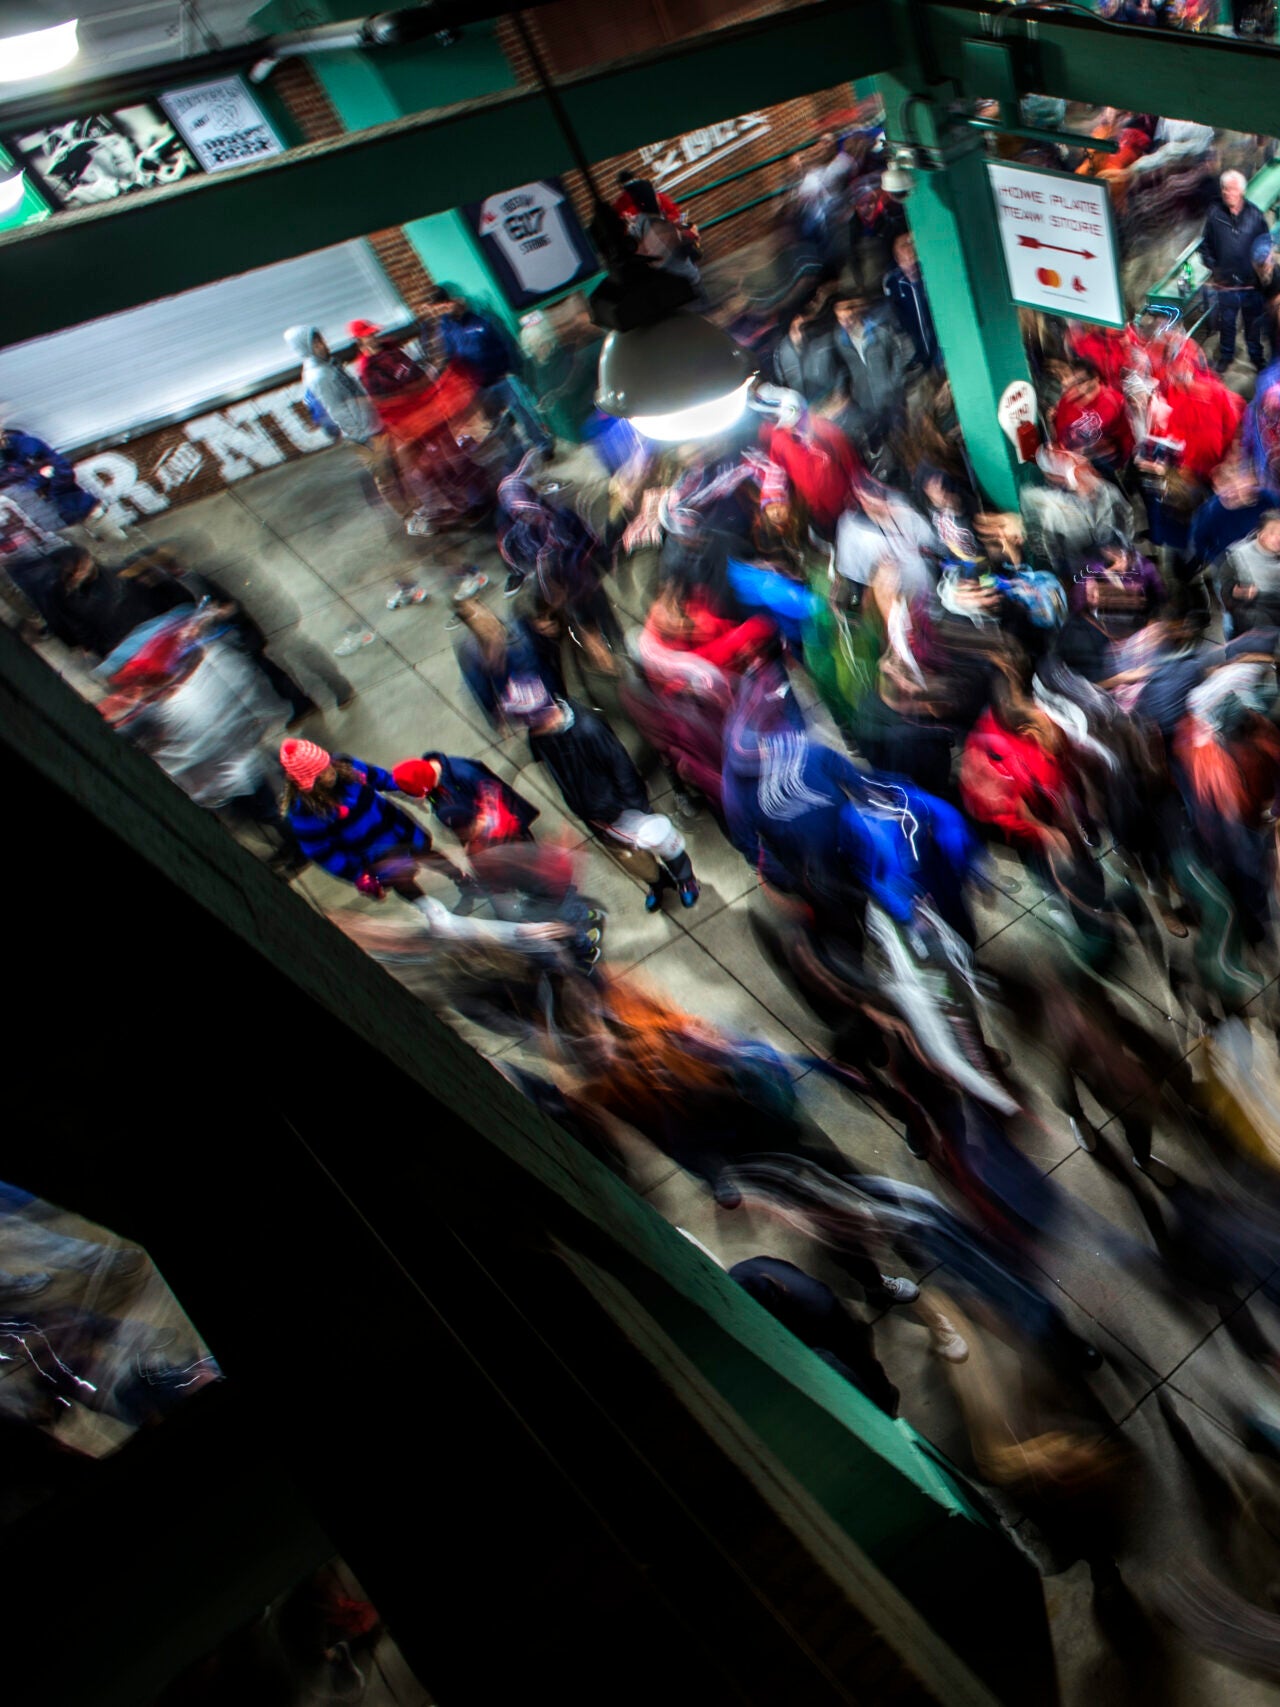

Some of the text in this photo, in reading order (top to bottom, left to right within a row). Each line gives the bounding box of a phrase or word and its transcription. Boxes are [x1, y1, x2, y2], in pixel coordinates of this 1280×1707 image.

[999, 185, 1102, 216] HOME PLATE
[1001, 205, 1104, 237] TEAM STORE
